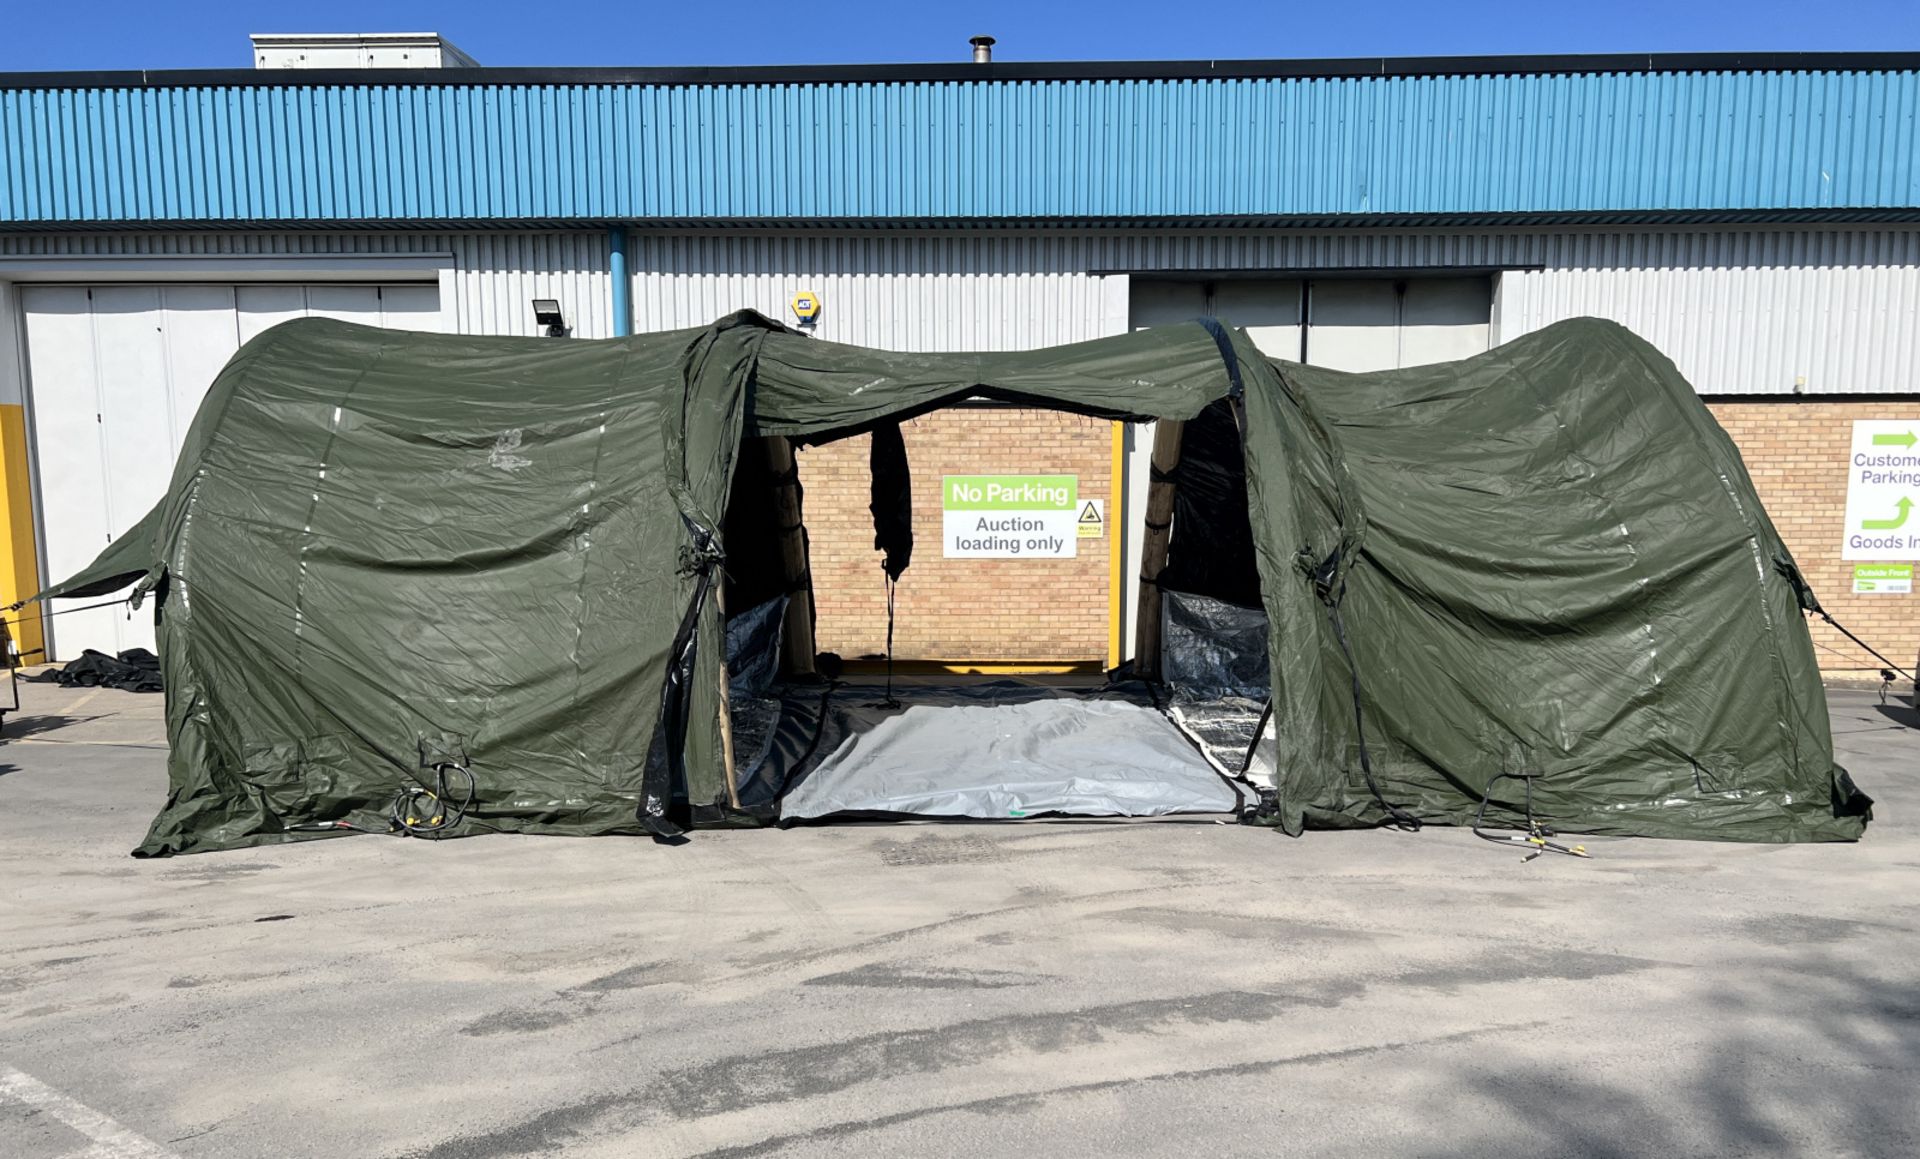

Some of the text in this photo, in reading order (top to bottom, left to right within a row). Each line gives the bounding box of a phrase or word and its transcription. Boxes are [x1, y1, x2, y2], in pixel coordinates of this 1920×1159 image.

[1854, 453, 1920, 467] Custom
[952, 483, 1069, 506] No Parking
[975, 517, 1044, 532] Auction
[956, 536, 1064, 554] loading only
[1849, 534, 1904, 549] Goods
[1888, 569, 1910, 577] Front
